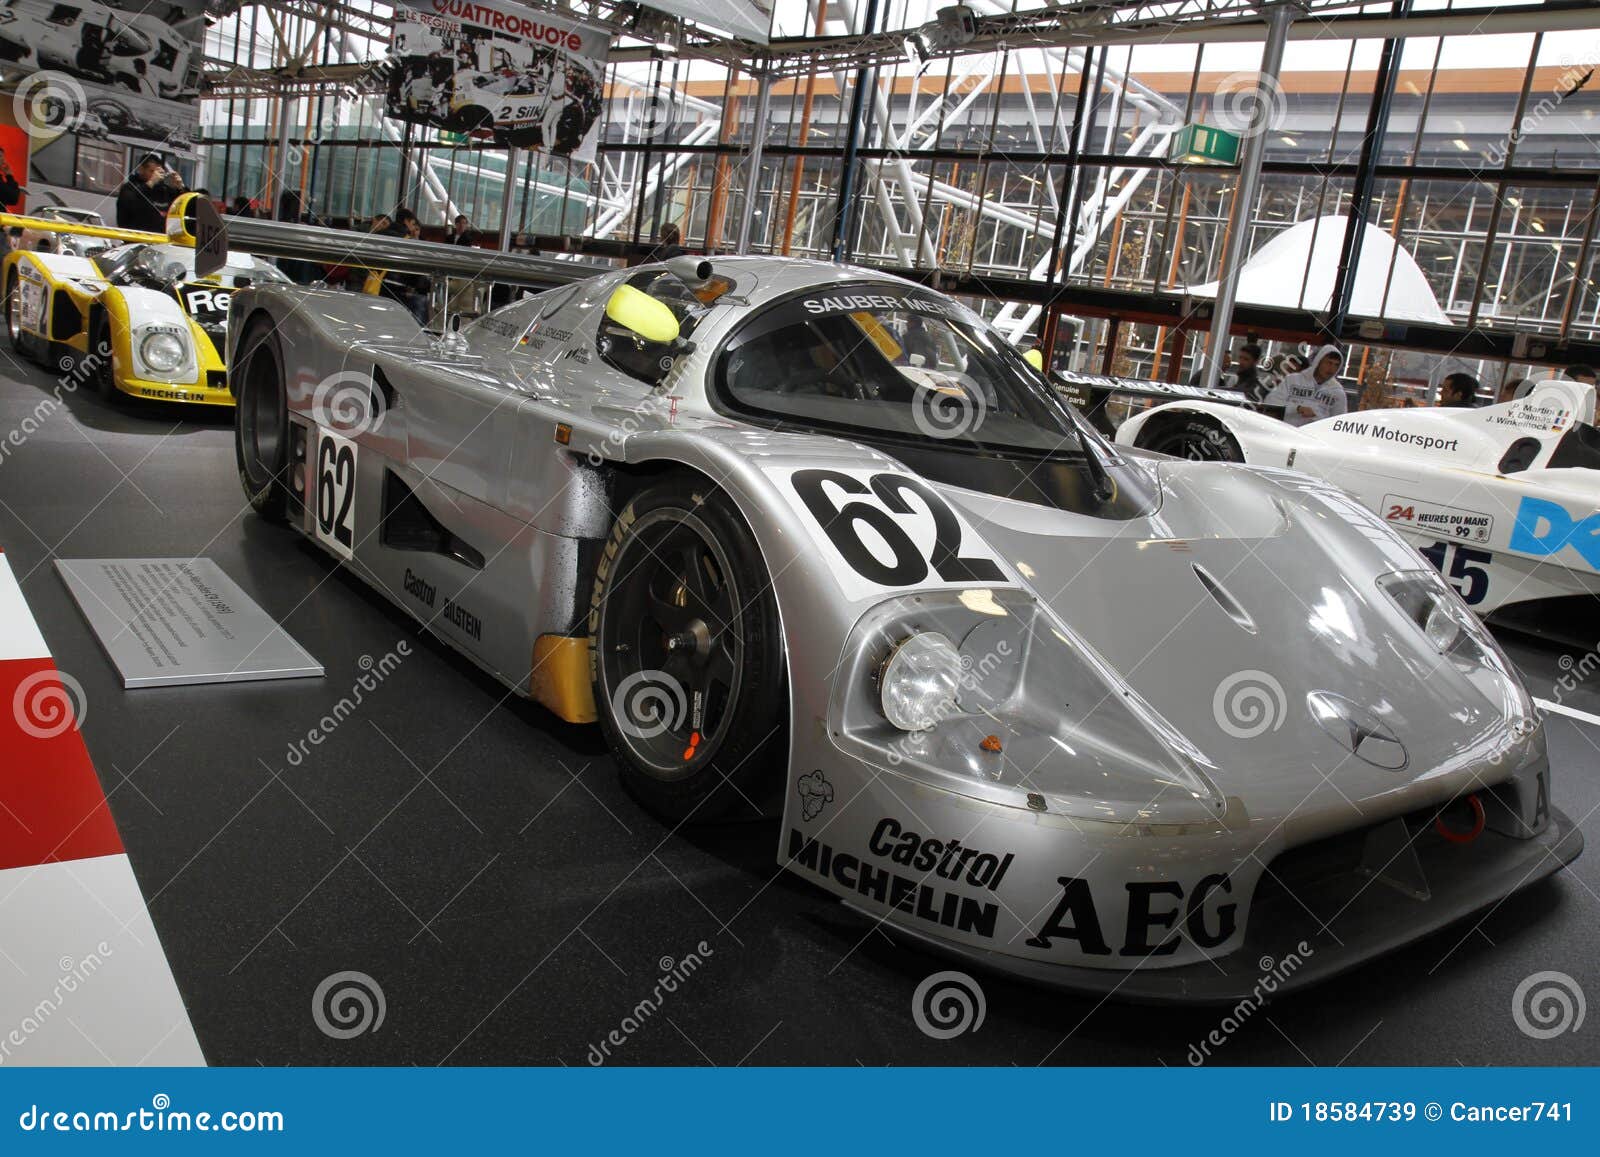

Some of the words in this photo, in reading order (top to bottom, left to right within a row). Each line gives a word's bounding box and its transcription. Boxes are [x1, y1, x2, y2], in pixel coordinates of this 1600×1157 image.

[405, 10, 418, 21] LE
[420, 14, 461, 32] REGINE
[499, 106, 512, 119] 2
[516, 105, 542, 119] Silk
[803, 295, 902, 314] SAUBER
[140, 388, 205, 401] MICHELIN
[1333, 420, 1369, 435] BMW
[1372, 425, 1459, 452] Motorsport
[318, 435, 355, 550] 62
[1387, 505, 1415, 521] 24
[1418, 513, 1449, 524] HEURES
[1450, 516, 1462, 525] DU
[1464, 517, 1489, 527] MANS
[791, 469, 1010, 587] 62
[1456, 527, 1471, 538] 99
[1418, 541, 1493, 606] 15
[404, 567, 436, 609] Castrol
[443, 597, 482, 641] BILSTEIN
[868, 818, 1015, 892] Castrol
[788, 828, 999, 938] MICHELIN
[1025, 873, 1238, 957] AEG
